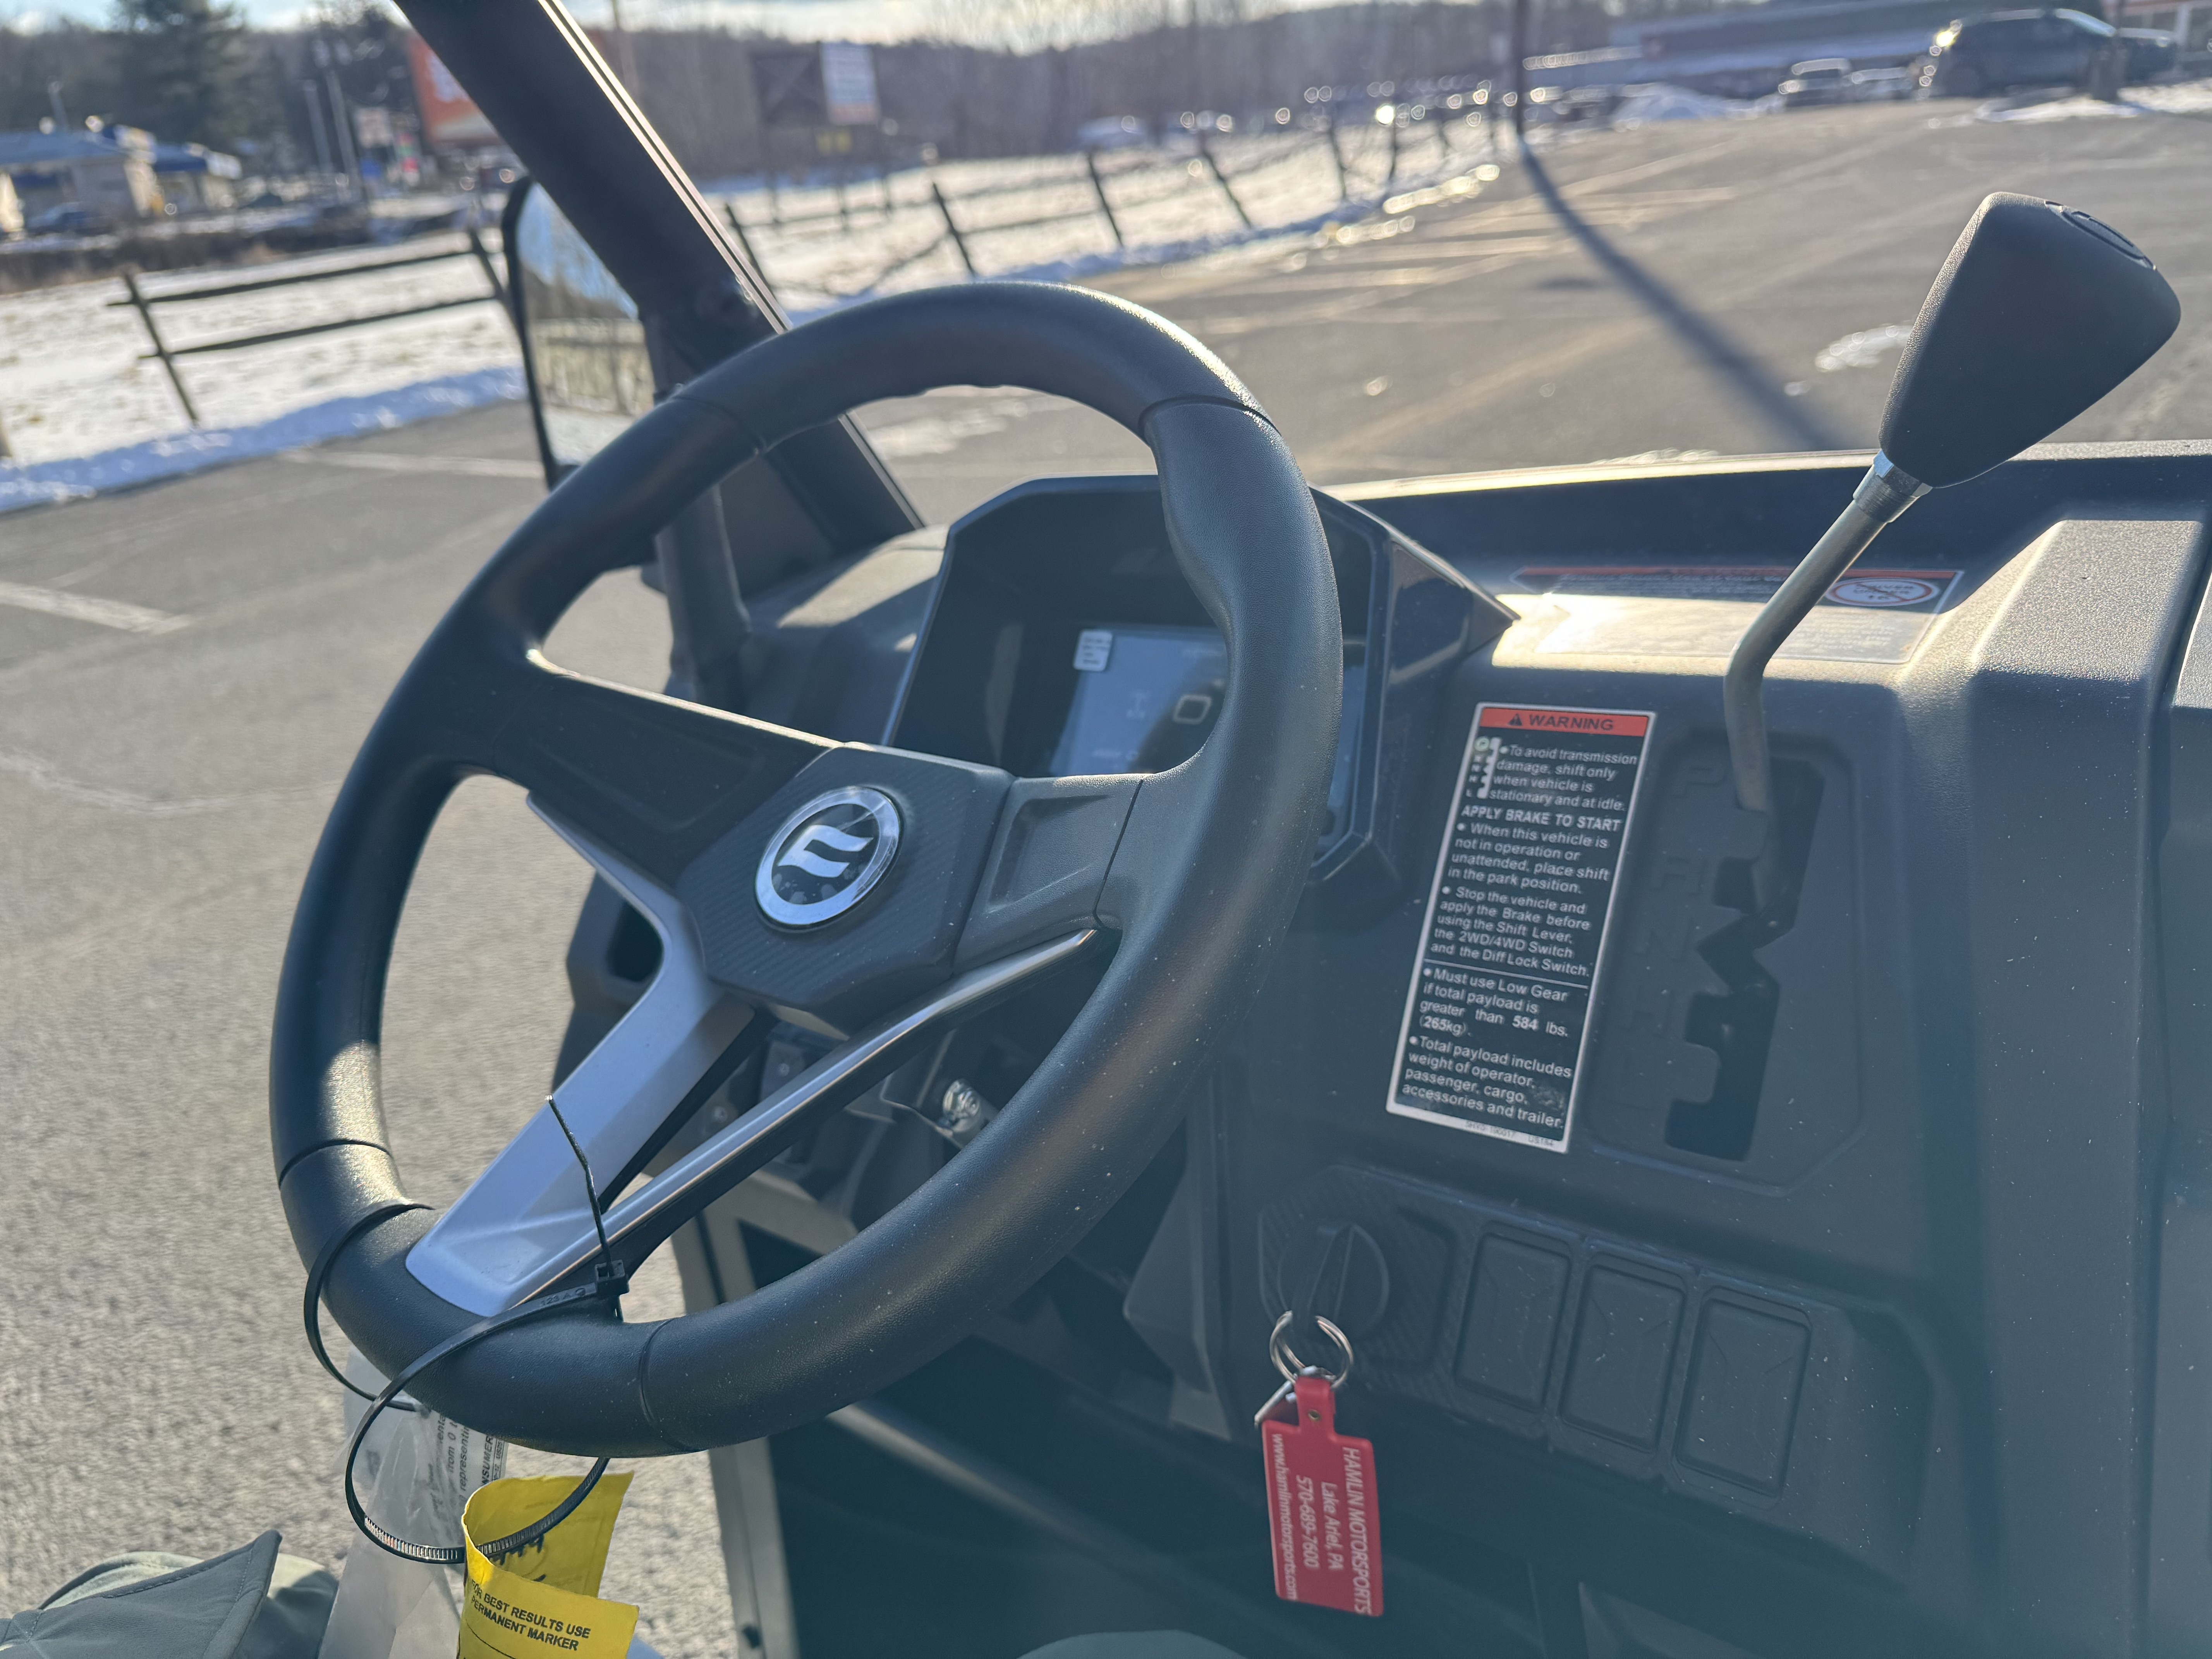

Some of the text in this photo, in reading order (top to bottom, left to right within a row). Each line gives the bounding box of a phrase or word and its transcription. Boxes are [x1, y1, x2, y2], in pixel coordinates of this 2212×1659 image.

[1529, 714, 1613, 731] WARNING
[1510, 745, 1637, 765] To avoid transmission
[1493, 775, 1594, 793] when vehicle is
[1555, 764, 1585, 776] shift
[1586, 767, 1618, 781] only
[1489, 789, 1553, 806] stationary
[1554, 795, 1580, 807] and
[1581, 798, 1597, 808] at
[1461, 805, 1621, 831] APPLY BRAKE TO START
[1455, 838, 1582, 861] not in operation or
[1470, 823, 1610, 848] When this vehicle is
[1448, 866, 1582, 894] in the park position.
[1533, 862, 1574, 876] place
[1577, 867, 1611, 881] shift
[1455, 886, 1587, 915] Stop the vehicle and
[1437, 915, 1471, 929] using
[1473, 919, 1495, 931] the
[1496, 921, 1528, 936] Shift
[1440, 901, 1592, 930] apply the Brake before
[1434, 929, 1575, 959] the 2WD/4WD Switch
[1431, 942, 1589, 977] and the Diff Lock Switch.
[1423, 982, 1540, 1015] if total payload is
[1434, 968, 1569, 1003] Must use Low Gear
[1419, 1000, 1569, 1037] greater than 584 lbs.
[1408, 1052, 1453, 1070] weight
[1455, 1062, 1471, 1074] of
[1419, 1035, 1573, 1079] Total payload includes
[1401, 1084, 1564, 1129] accessories and trailer.
[1272, 1434, 1297, 1601] www.hamlinmotorsports.com
[1296, 1475, 1320, 1568] 570-689-7600
[1321, 1482, 1344, 1570] Lake Ariel, PA
[1342, 1447, 1372, 1616] HAMLIN MOTORSPORTS
[472, 1579, 591, 1638] FOR BEST RESULTS USE
[472, 1595, 579, 1651] PERMANENT MARKER
